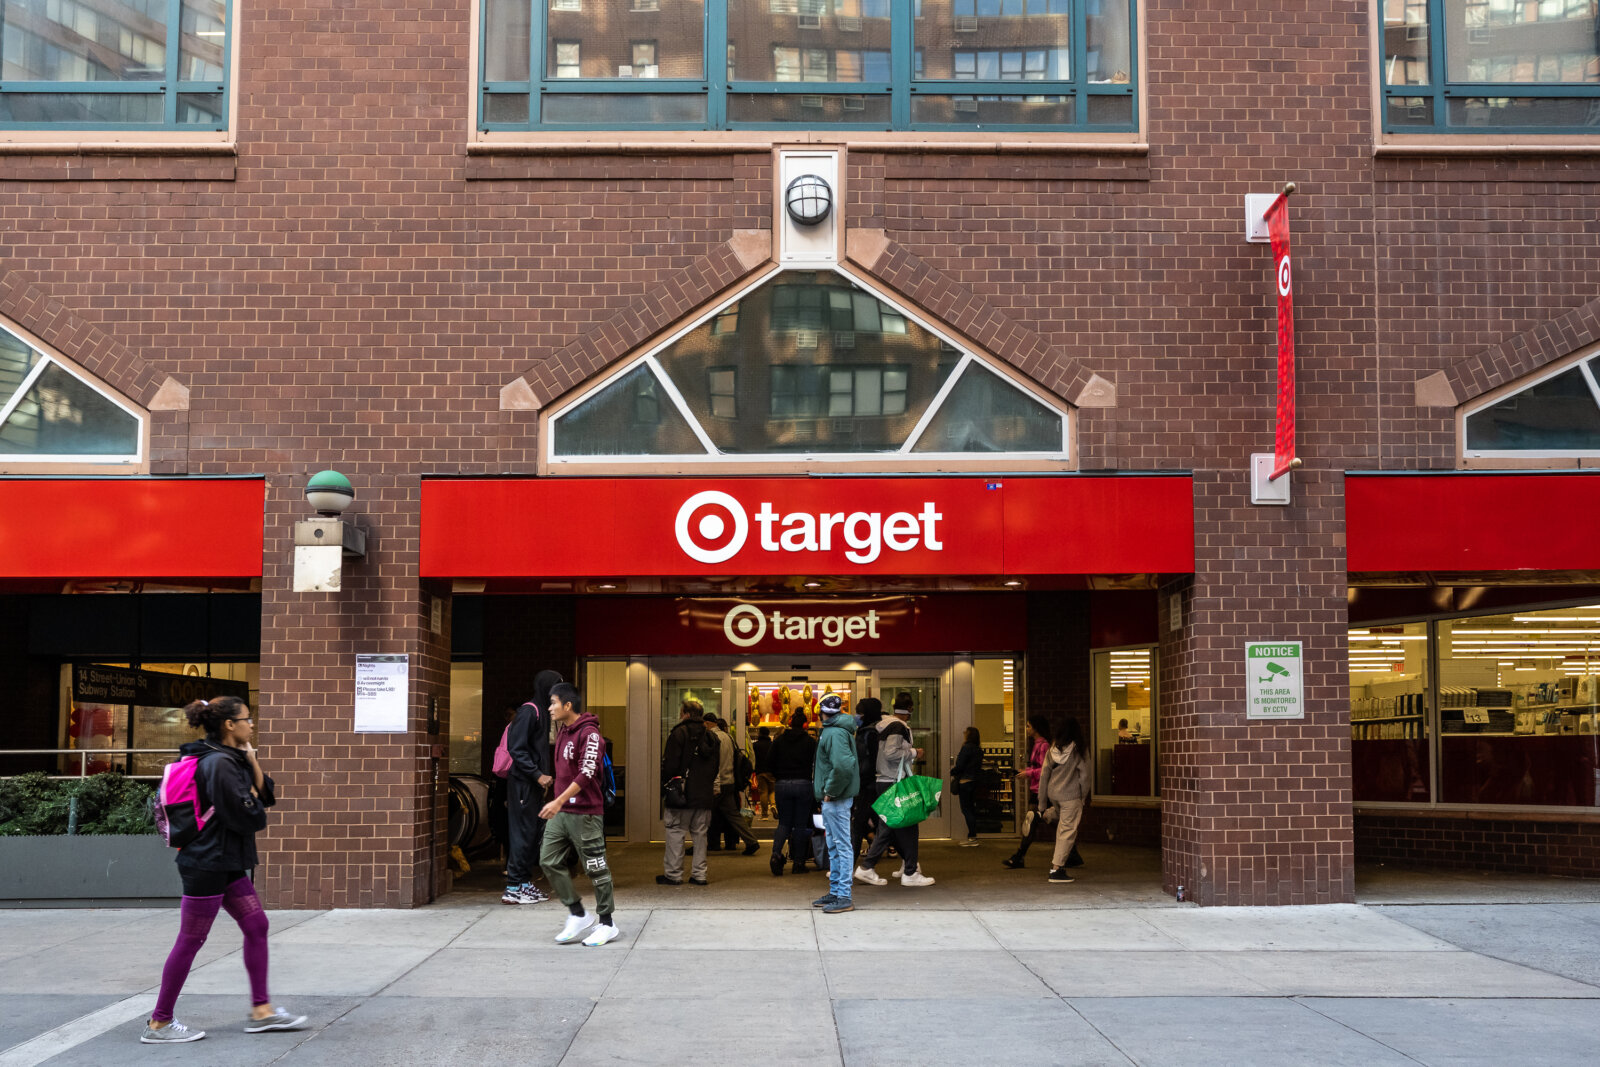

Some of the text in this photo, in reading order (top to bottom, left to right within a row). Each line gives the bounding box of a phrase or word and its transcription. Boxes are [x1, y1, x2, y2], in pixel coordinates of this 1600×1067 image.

[755, 502, 943, 564] target
[770, 610, 880, 647] target
[1255, 646, 1294, 656] NOTICE
[79, 669, 88, 681] 14
[137, 675, 147, 689] Sq
[79, 682, 136, 698] Subway Station
